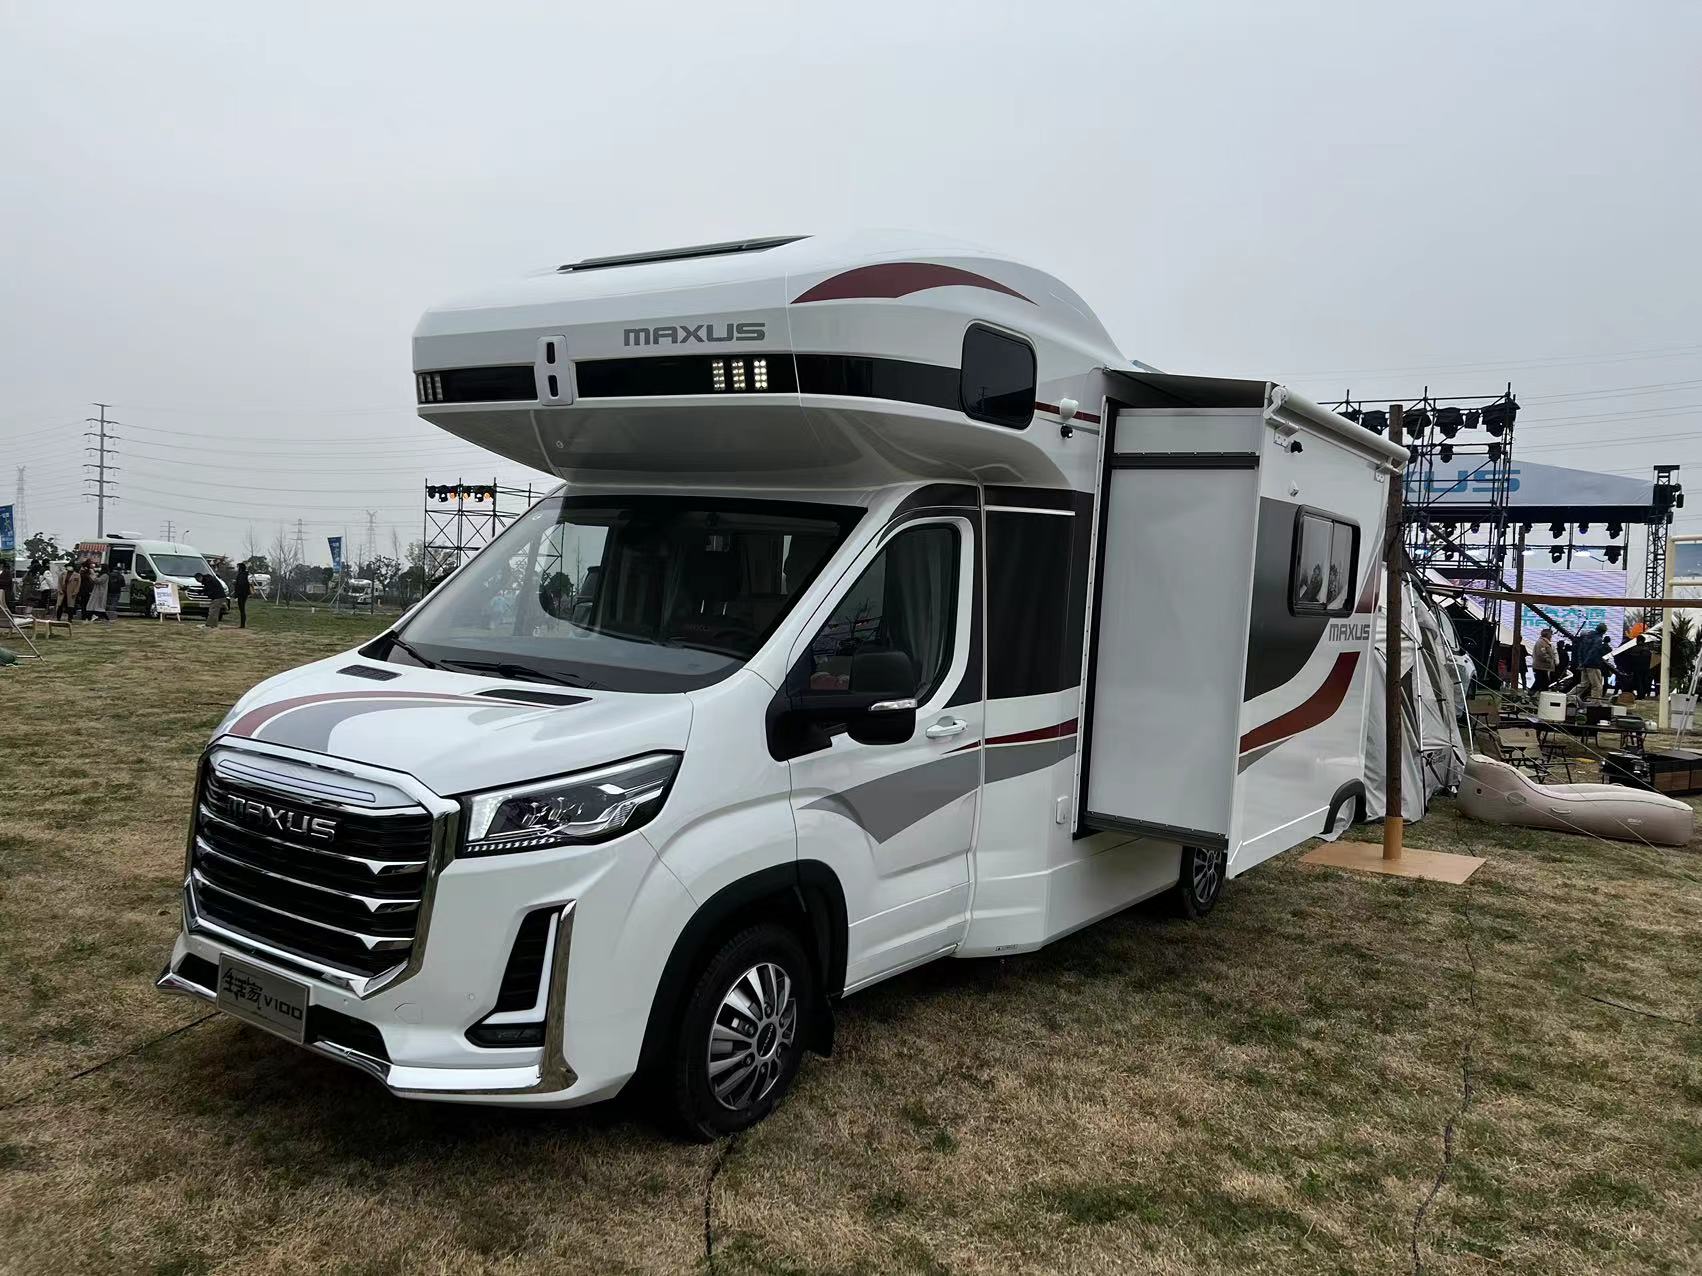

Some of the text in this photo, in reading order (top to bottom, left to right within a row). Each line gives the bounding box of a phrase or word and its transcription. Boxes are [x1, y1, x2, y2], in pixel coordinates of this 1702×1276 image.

[623, 322, 766, 347] MAXUS
[1328, 623, 1371, 642] MAXUS
[227, 794, 337, 841] MAXUS
